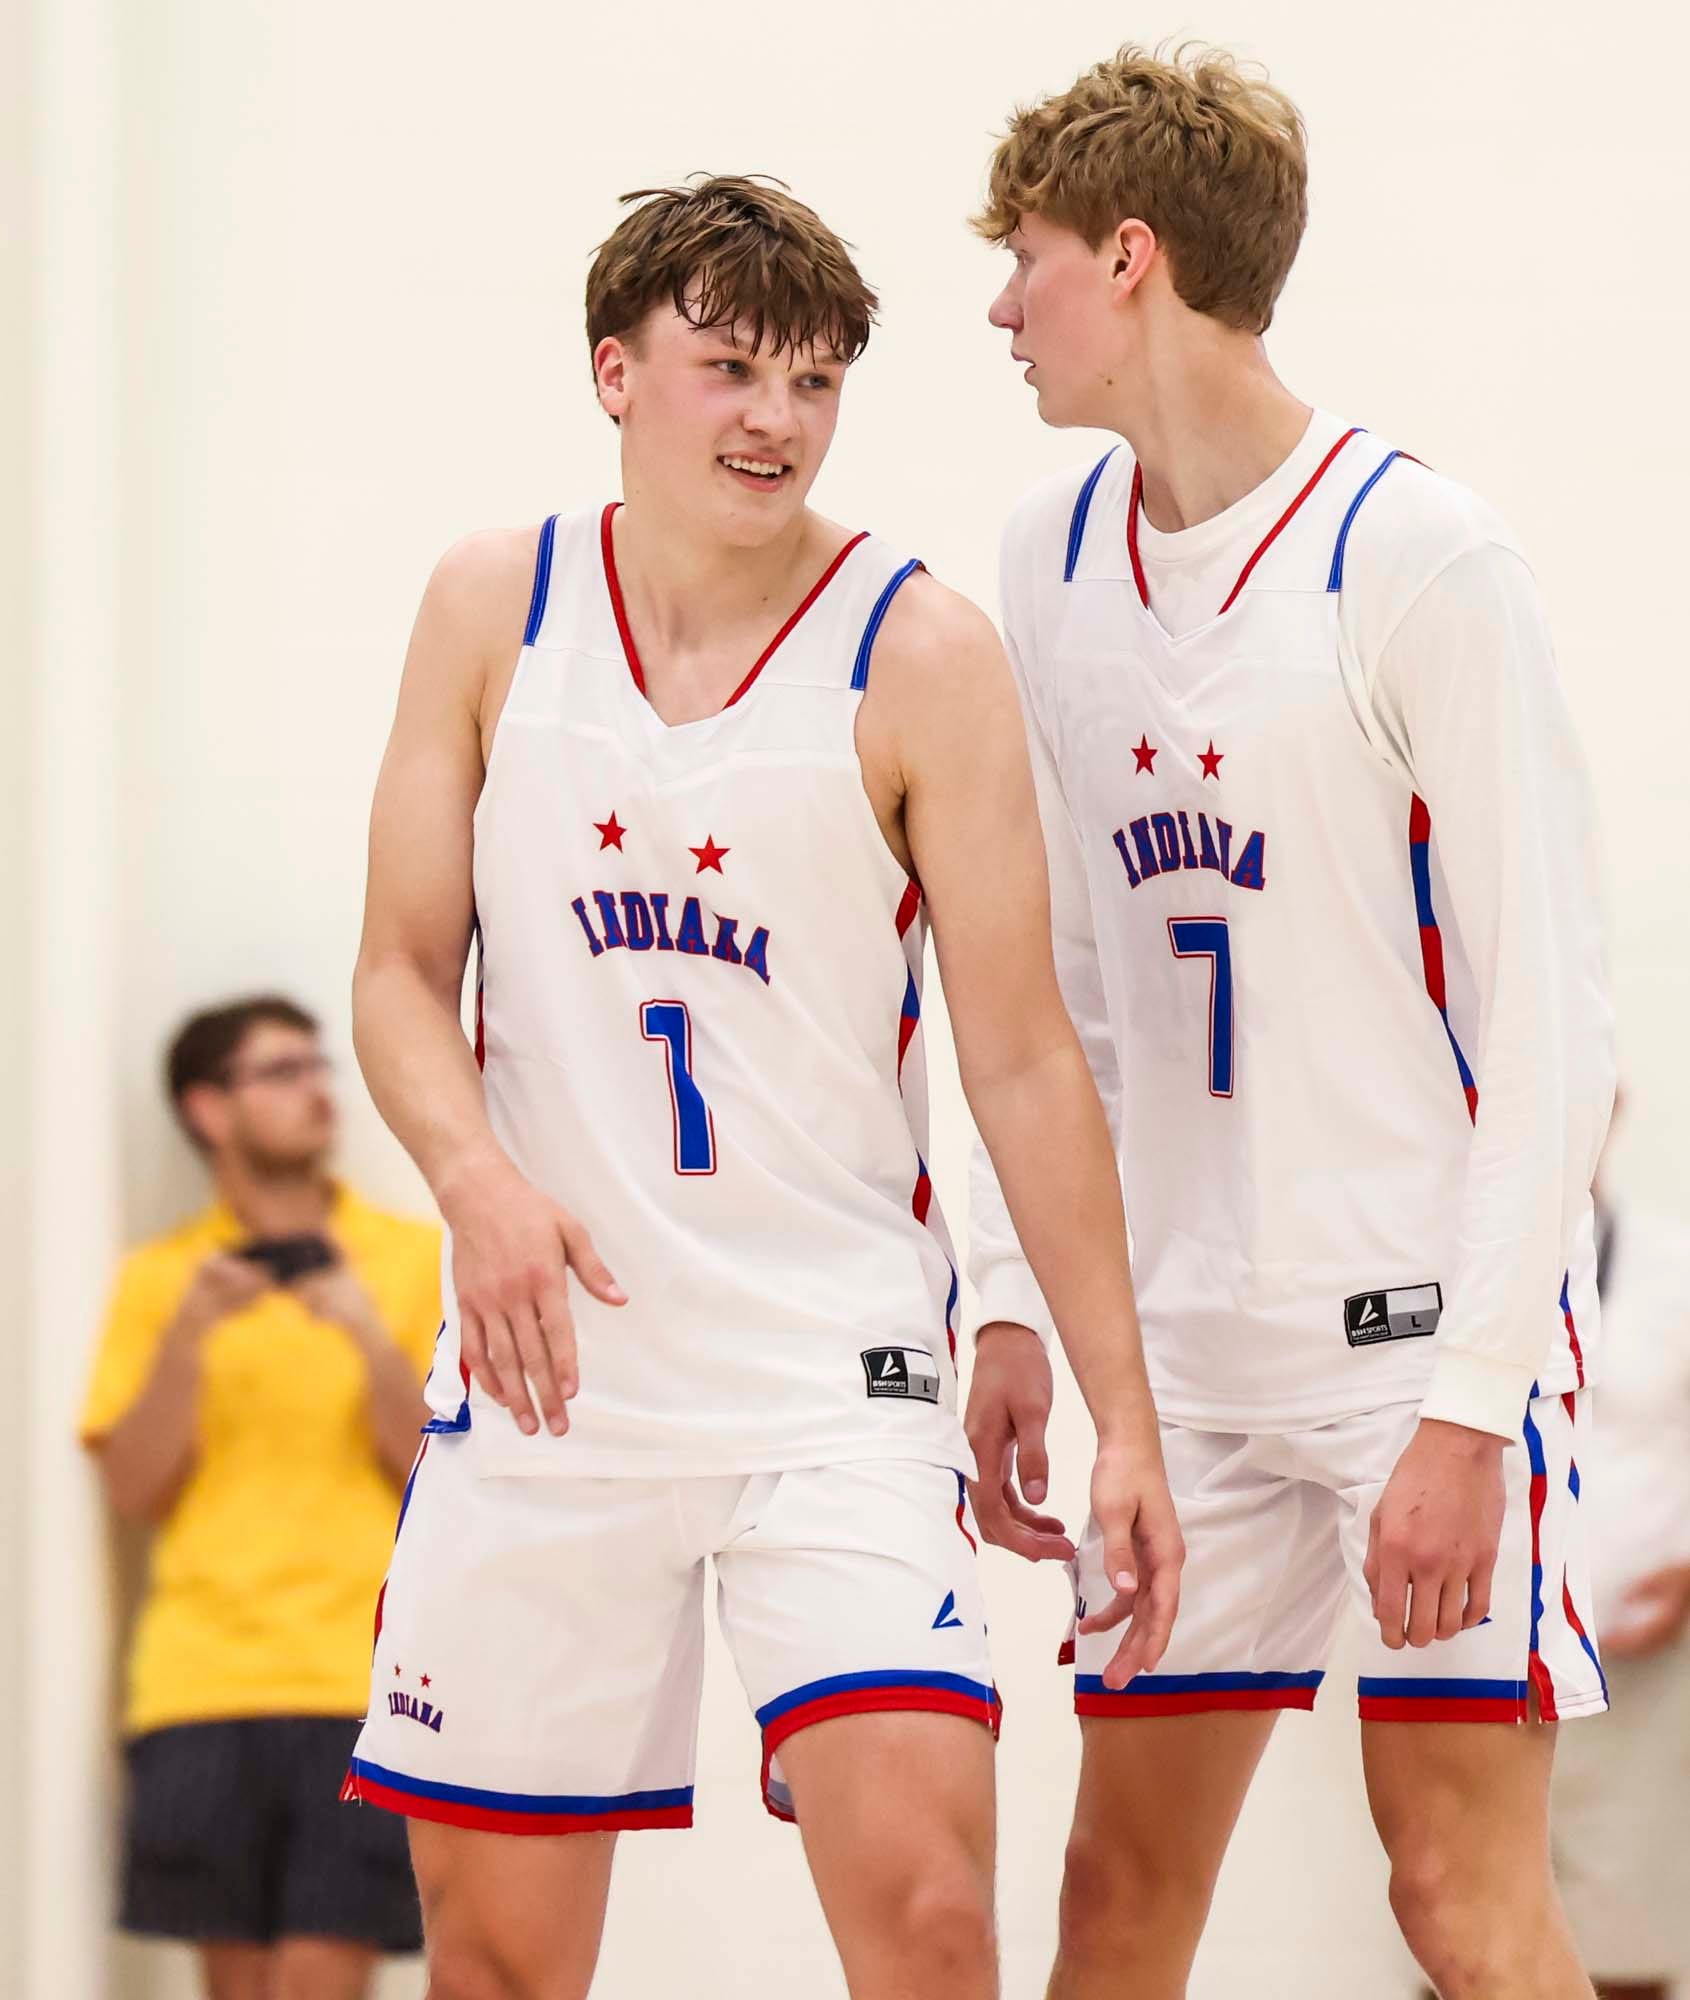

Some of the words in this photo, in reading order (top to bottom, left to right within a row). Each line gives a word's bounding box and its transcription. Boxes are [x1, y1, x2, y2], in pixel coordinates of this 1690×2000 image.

[1112, 811, 1266, 891] INDIANA
[571, 890, 770, 986] INDIANA
[1167, 917, 1235, 1098] 7
[639, 998, 717, 1176] 1
[1410, 1315, 1422, 1329] L
[923, 1379, 931, 1393] L
[388, 1691, 443, 1733] INDIANA
